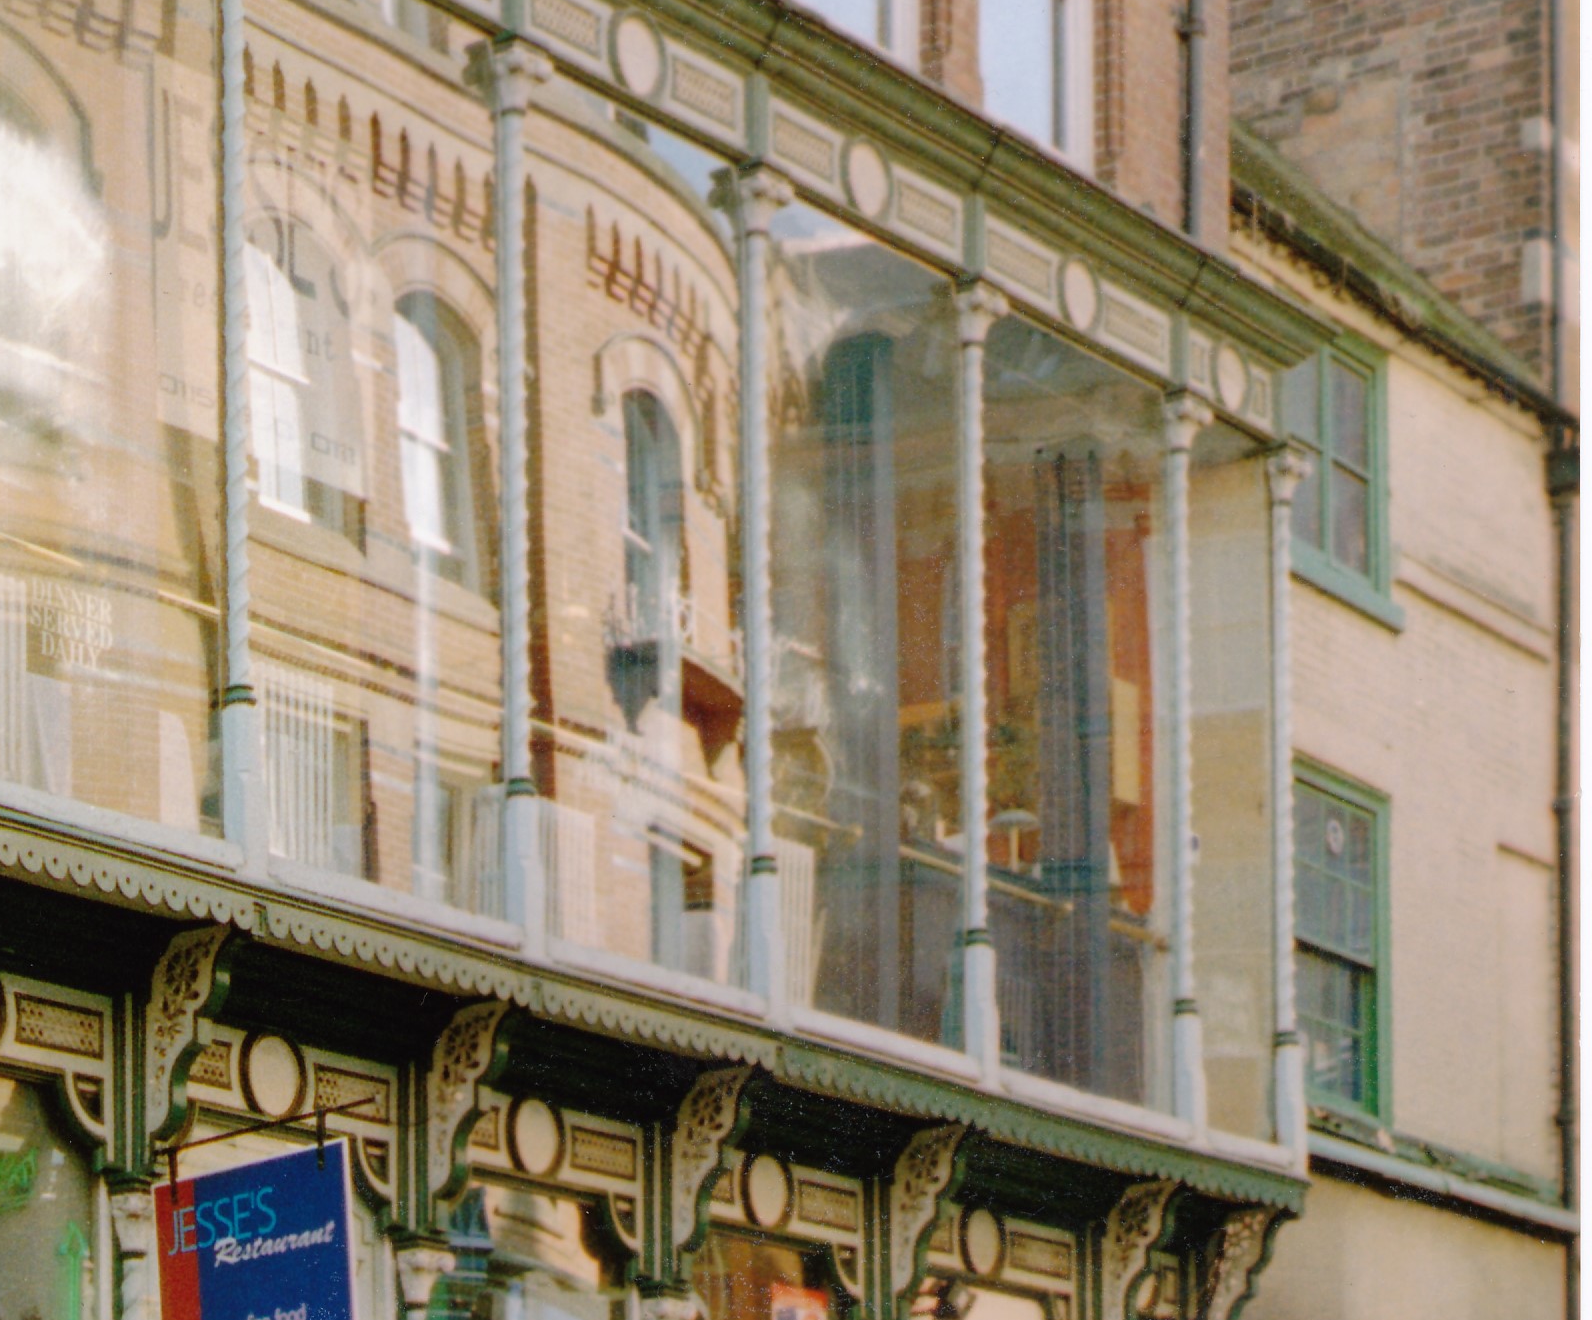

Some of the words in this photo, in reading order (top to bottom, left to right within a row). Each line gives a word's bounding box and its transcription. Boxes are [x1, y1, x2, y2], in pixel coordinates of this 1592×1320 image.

[30, 603, 113, 649] SERVED
[31, 576, 112, 626] DINNER
[41, 630, 102, 669] DAILY
[168, 1186, 277, 1256] JESSE'S
[213, 1219, 335, 1269] Restaurant
